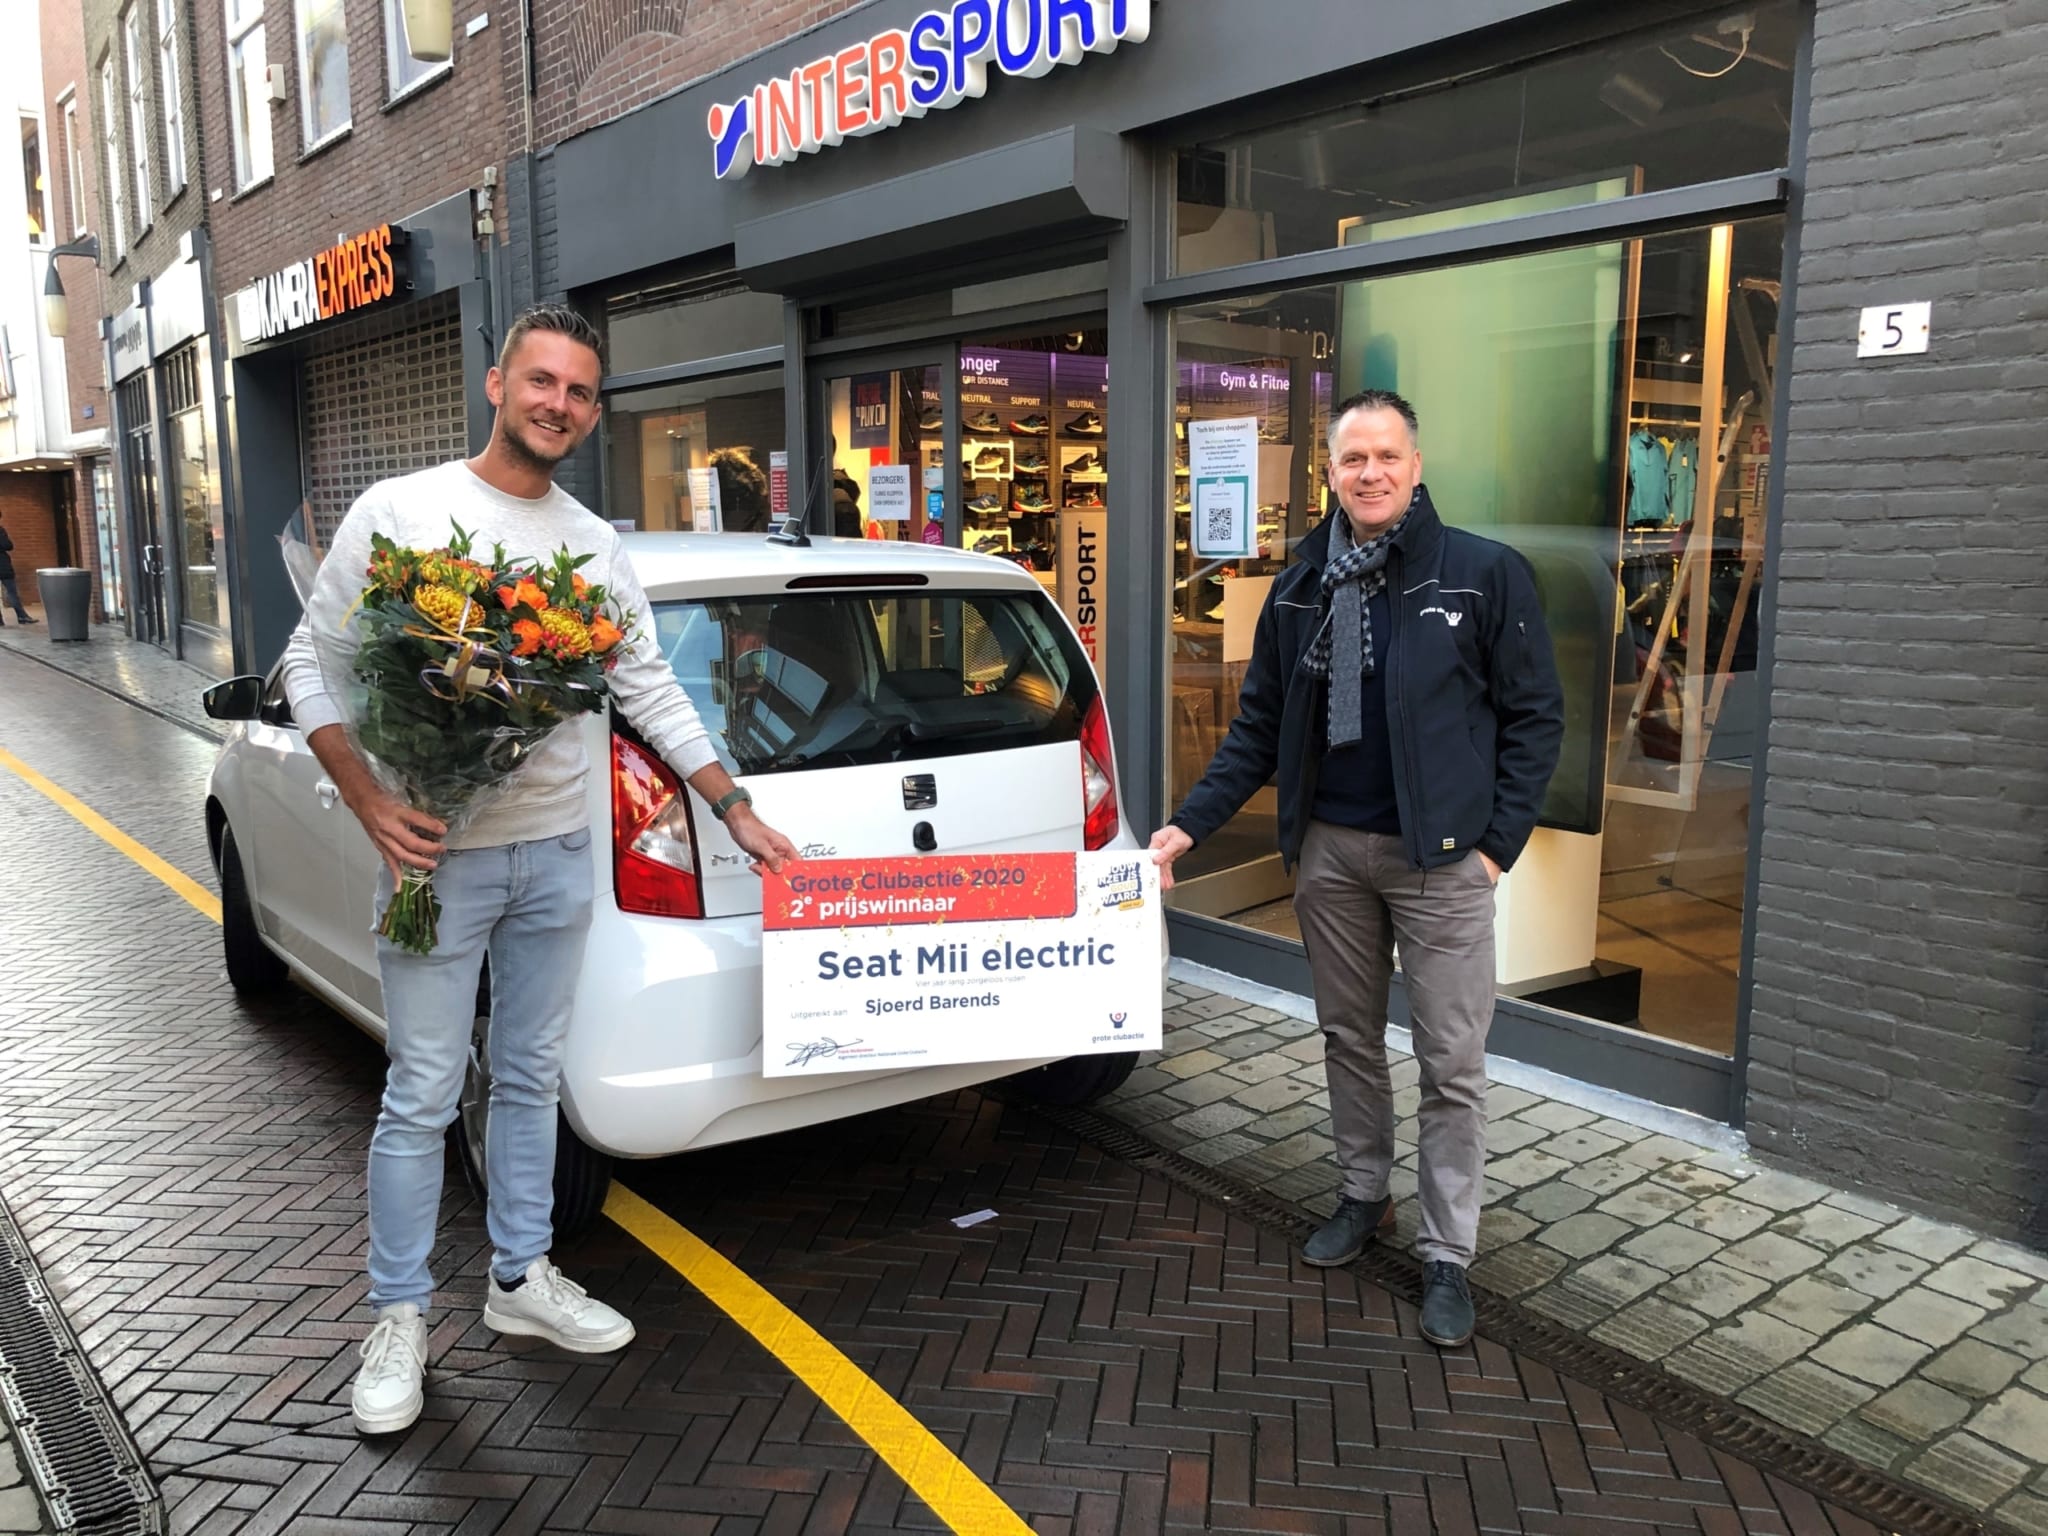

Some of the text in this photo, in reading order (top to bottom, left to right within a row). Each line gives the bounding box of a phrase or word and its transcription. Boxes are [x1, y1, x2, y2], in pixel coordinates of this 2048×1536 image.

[1882, 311, 1903, 349] 5
[977, 377, 1009, 386] DISTANCE
[1220, 371, 1246, 391] Gym
[1249, 373, 1258, 389] &
[961, 393, 993, 404] NEUTRAL
[1010, 396, 1041, 406] SUPPORT
[1067, 400, 1096, 409] NEUTRAL
[791, 867, 1026, 893] Grote Clubactie 2020
[819, 894, 957, 920] prijswinnaar
[817, 937, 1116, 981] Seat Mii electric
[865, 991, 1001, 1016] Sjoerd Barends
[832, 1008, 848, 1017] aan
[1091, 1032, 1144, 1044] grote clubactie
